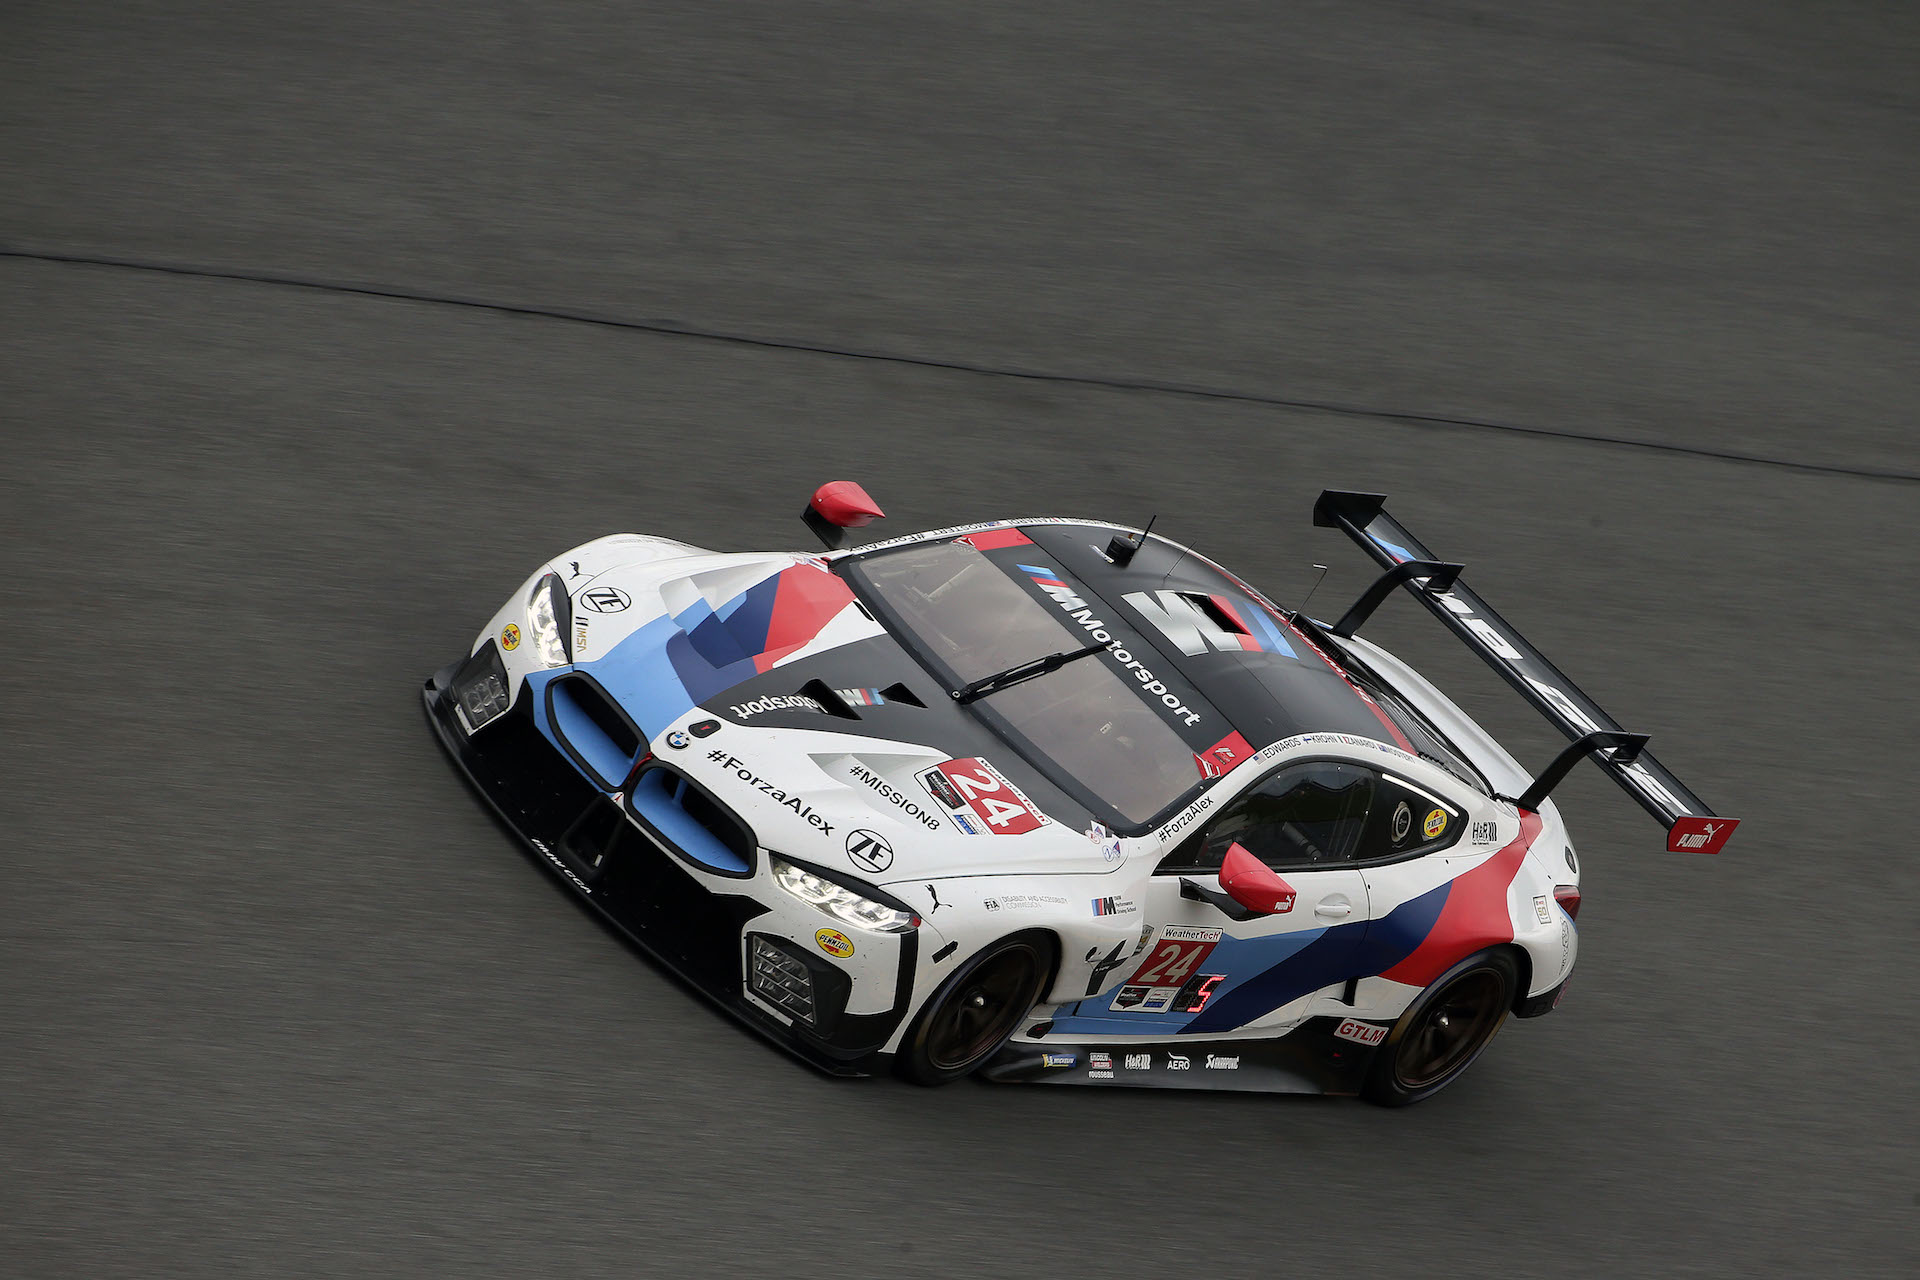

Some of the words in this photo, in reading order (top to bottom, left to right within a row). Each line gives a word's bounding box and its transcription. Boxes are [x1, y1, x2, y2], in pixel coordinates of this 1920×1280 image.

[583, 588, 629, 612] ZF
[576, 627, 587, 653] IMSA
[1070, 609, 1201, 728] Motorsport
[730, 694, 829, 720] otorsport
[1263, 737, 1302, 759] EDWARDS
[1311, 734, 1338, 744] KROHN
[1348, 736, 1377, 750] ZANARDI
[706, 749, 835, 837] #ForzaAlex
[849, 765, 941, 831] #MISSION8
[950, 768, 1027, 828] 24
[1158, 796, 1214, 843] #ForzaAlex
[849, 832, 893, 871] ZF
[1676, 833, 1709, 848] PUMA
[984, 899, 1000, 910] FIA
[819, 934, 850, 952] PENNZOIL
[1165, 928, 1221, 940] WeatherTech
[1137, 944, 1205, 984] 24
[1340, 1022, 1385, 1043] GTLM
[1167, 1060, 1190, 1070] AERO
